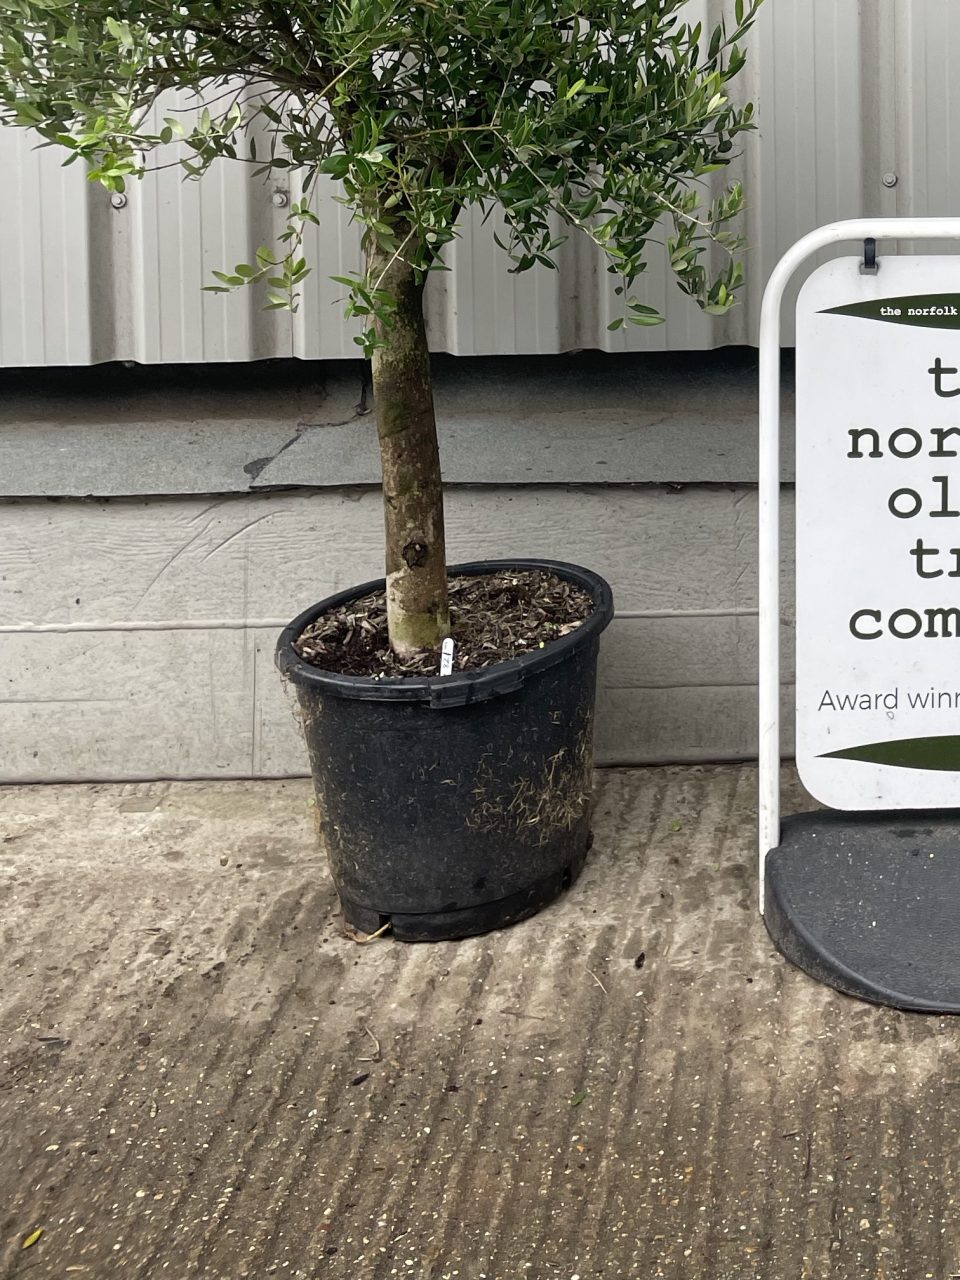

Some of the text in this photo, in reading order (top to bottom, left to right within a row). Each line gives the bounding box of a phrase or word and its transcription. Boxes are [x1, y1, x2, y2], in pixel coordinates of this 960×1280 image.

[880, 306, 901, 316] the
[907, 306, 958, 316] norfolk
[818, 687, 898, 712] Award
